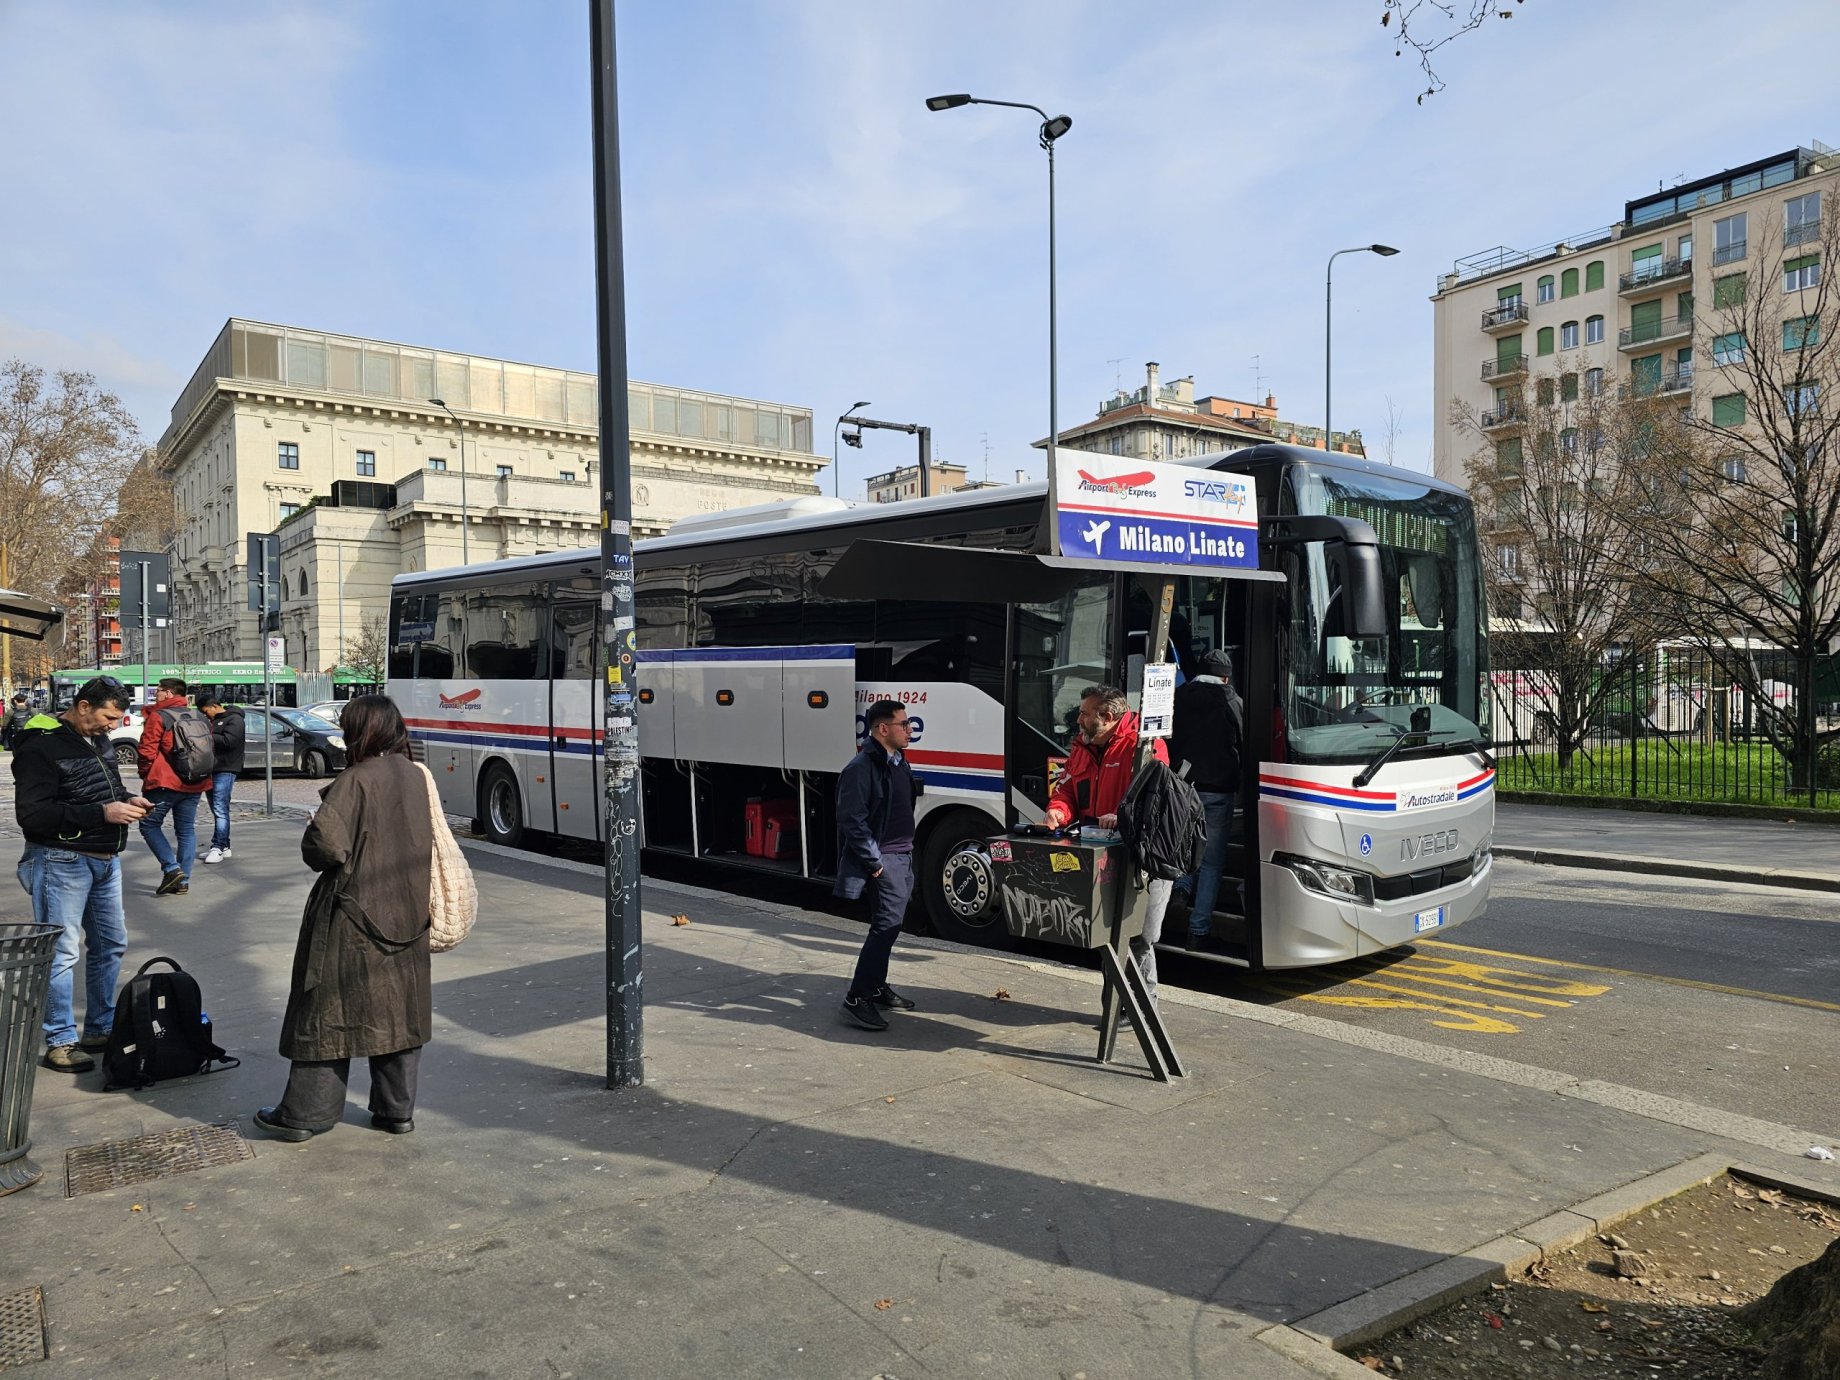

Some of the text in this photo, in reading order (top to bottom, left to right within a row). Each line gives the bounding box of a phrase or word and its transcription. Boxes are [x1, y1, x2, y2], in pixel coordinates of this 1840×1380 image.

[1078, 480, 1108, 493] Airport
[1128, 486, 1157, 498] Express
[1120, 525, 1245, 558] Milano Linate
[1148, 677, 1172, 688] Linate
[898, 692, 927, 704] 1924
[464, 703, 482, 711] Express
[1408, 791, 1455, 808] Autostradale
[1401, 829, 1459, 862] IVECO
[956, 874, 973, 895] IVECO
